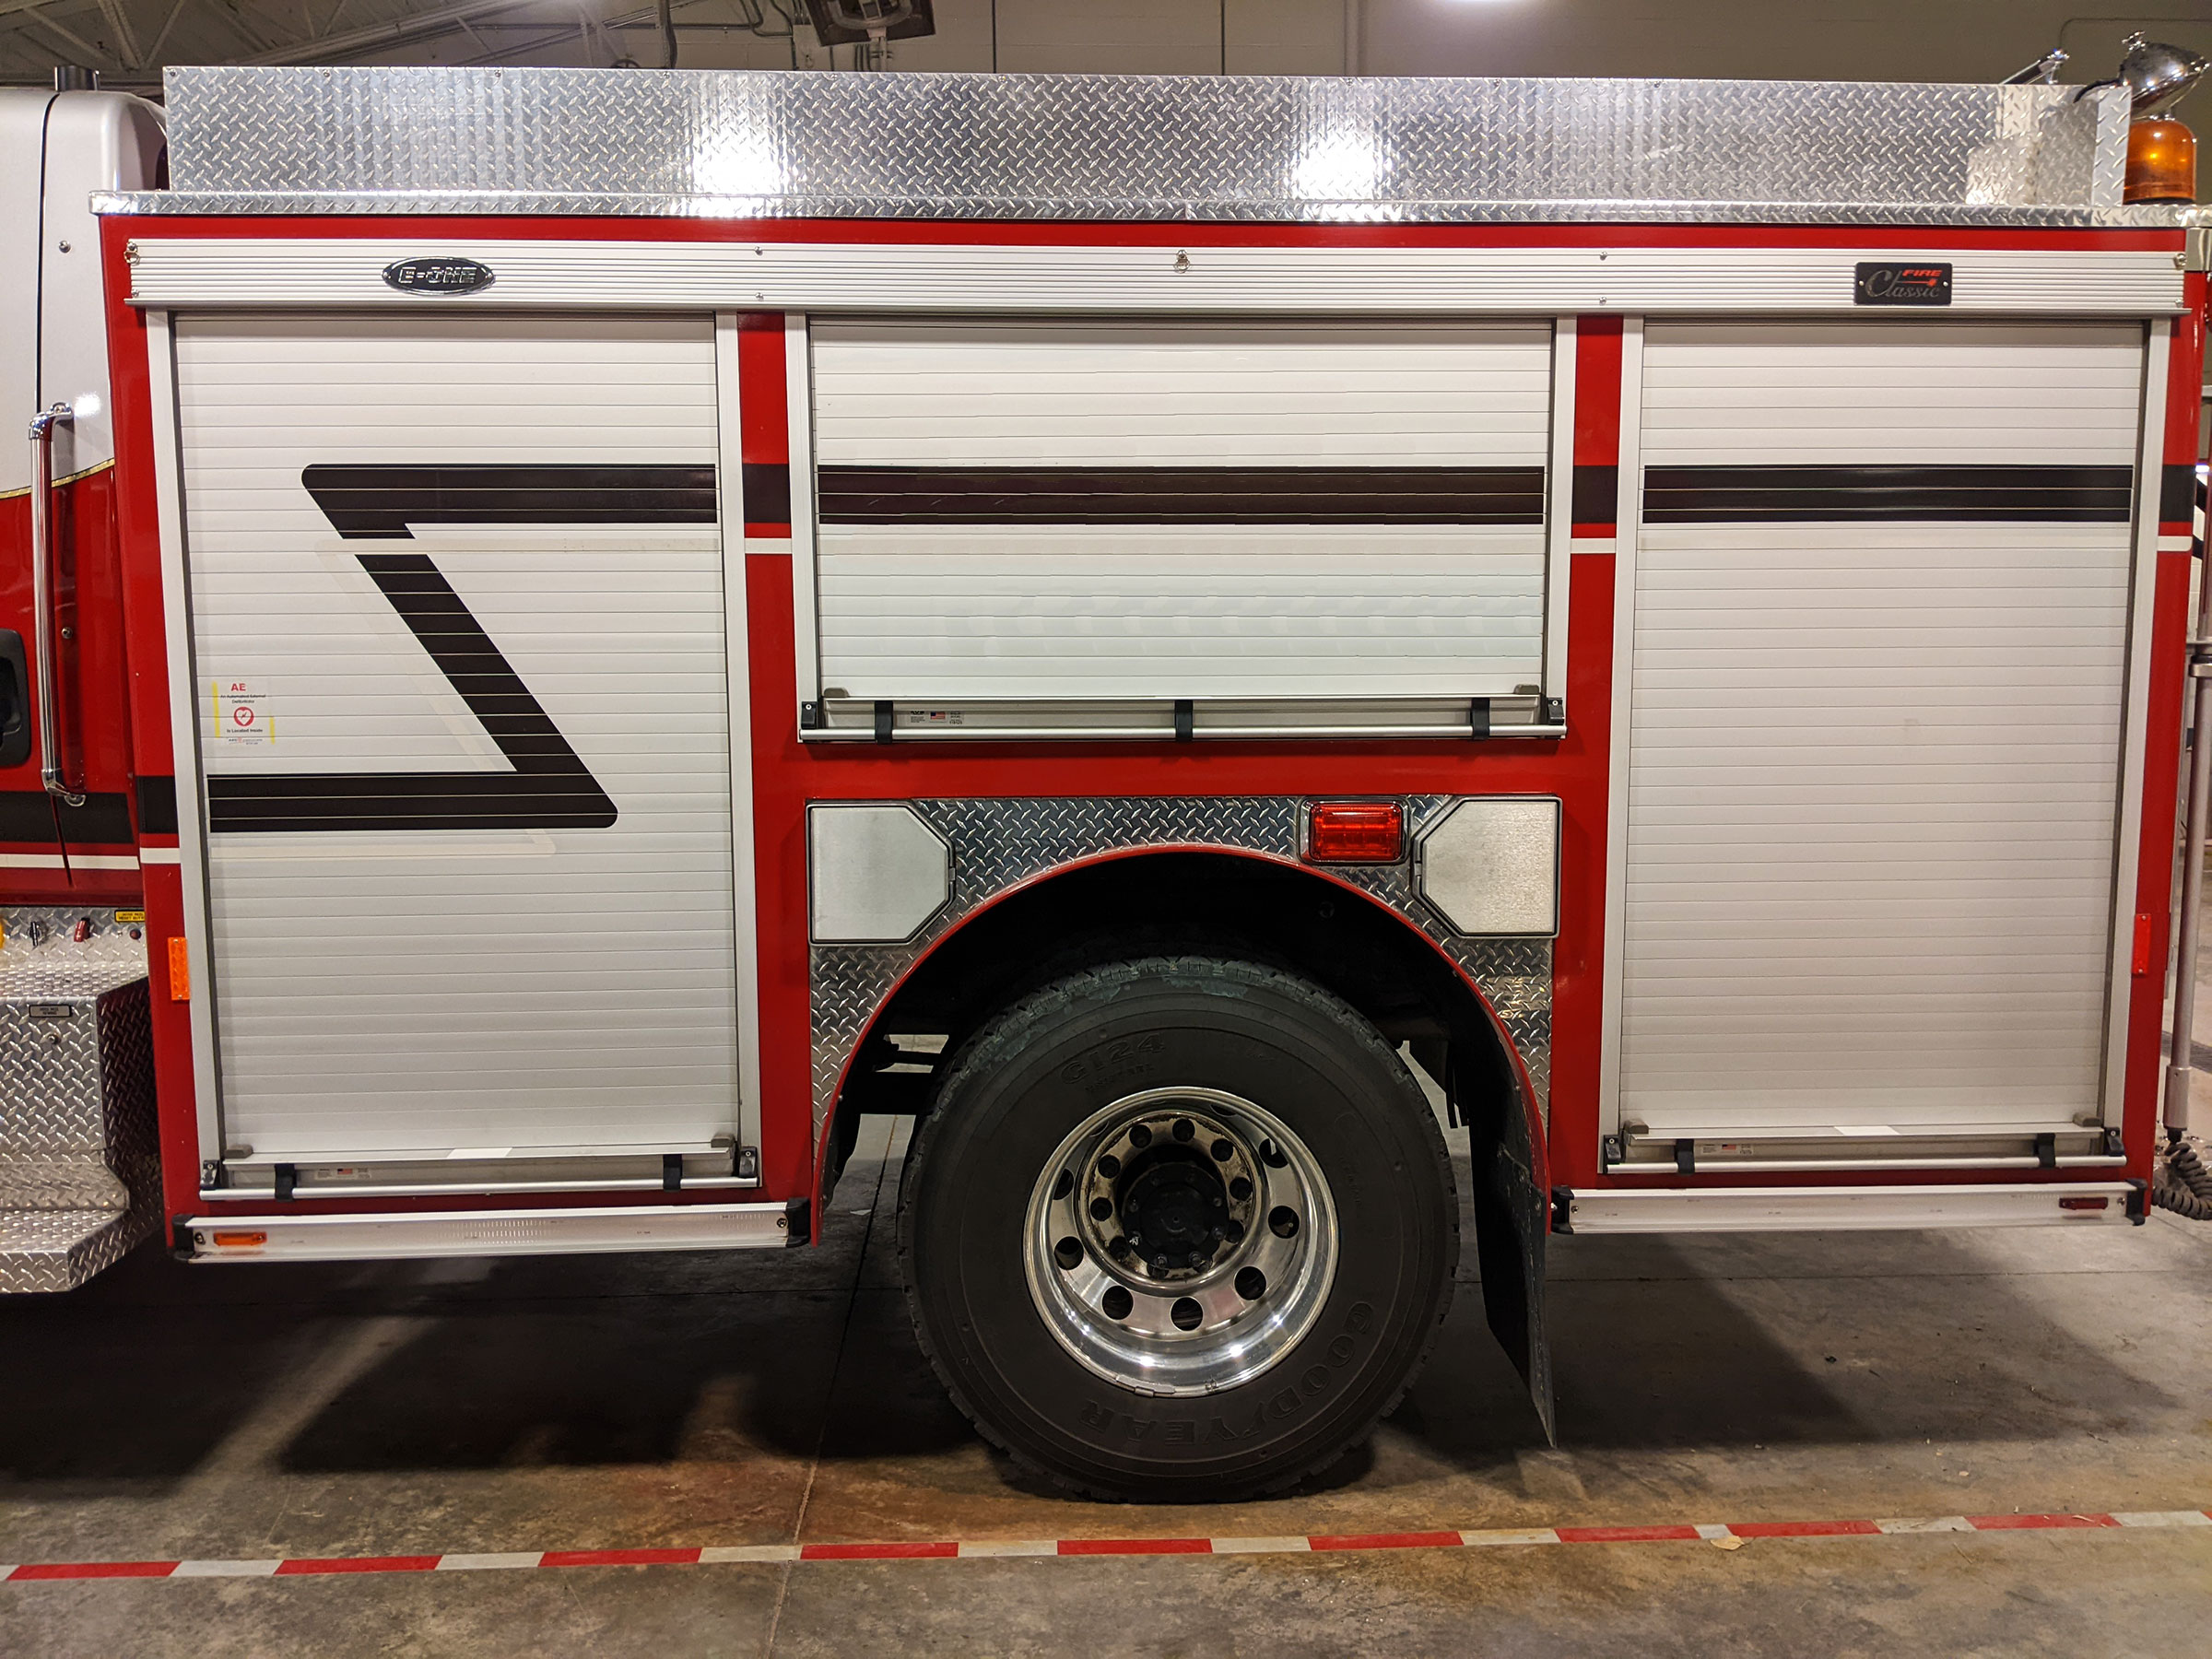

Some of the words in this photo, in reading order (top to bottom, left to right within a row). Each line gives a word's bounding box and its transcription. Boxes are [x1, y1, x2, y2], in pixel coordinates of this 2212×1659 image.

[397, 266, 477, 284] E-ONE
[1901, 269, 1943, 277] FIRE
[1865, 269, 1940, 298] Classic
[230, 683, 246, 691] AE
[1077, 1301, 1373, 1445] GOODYEAR
